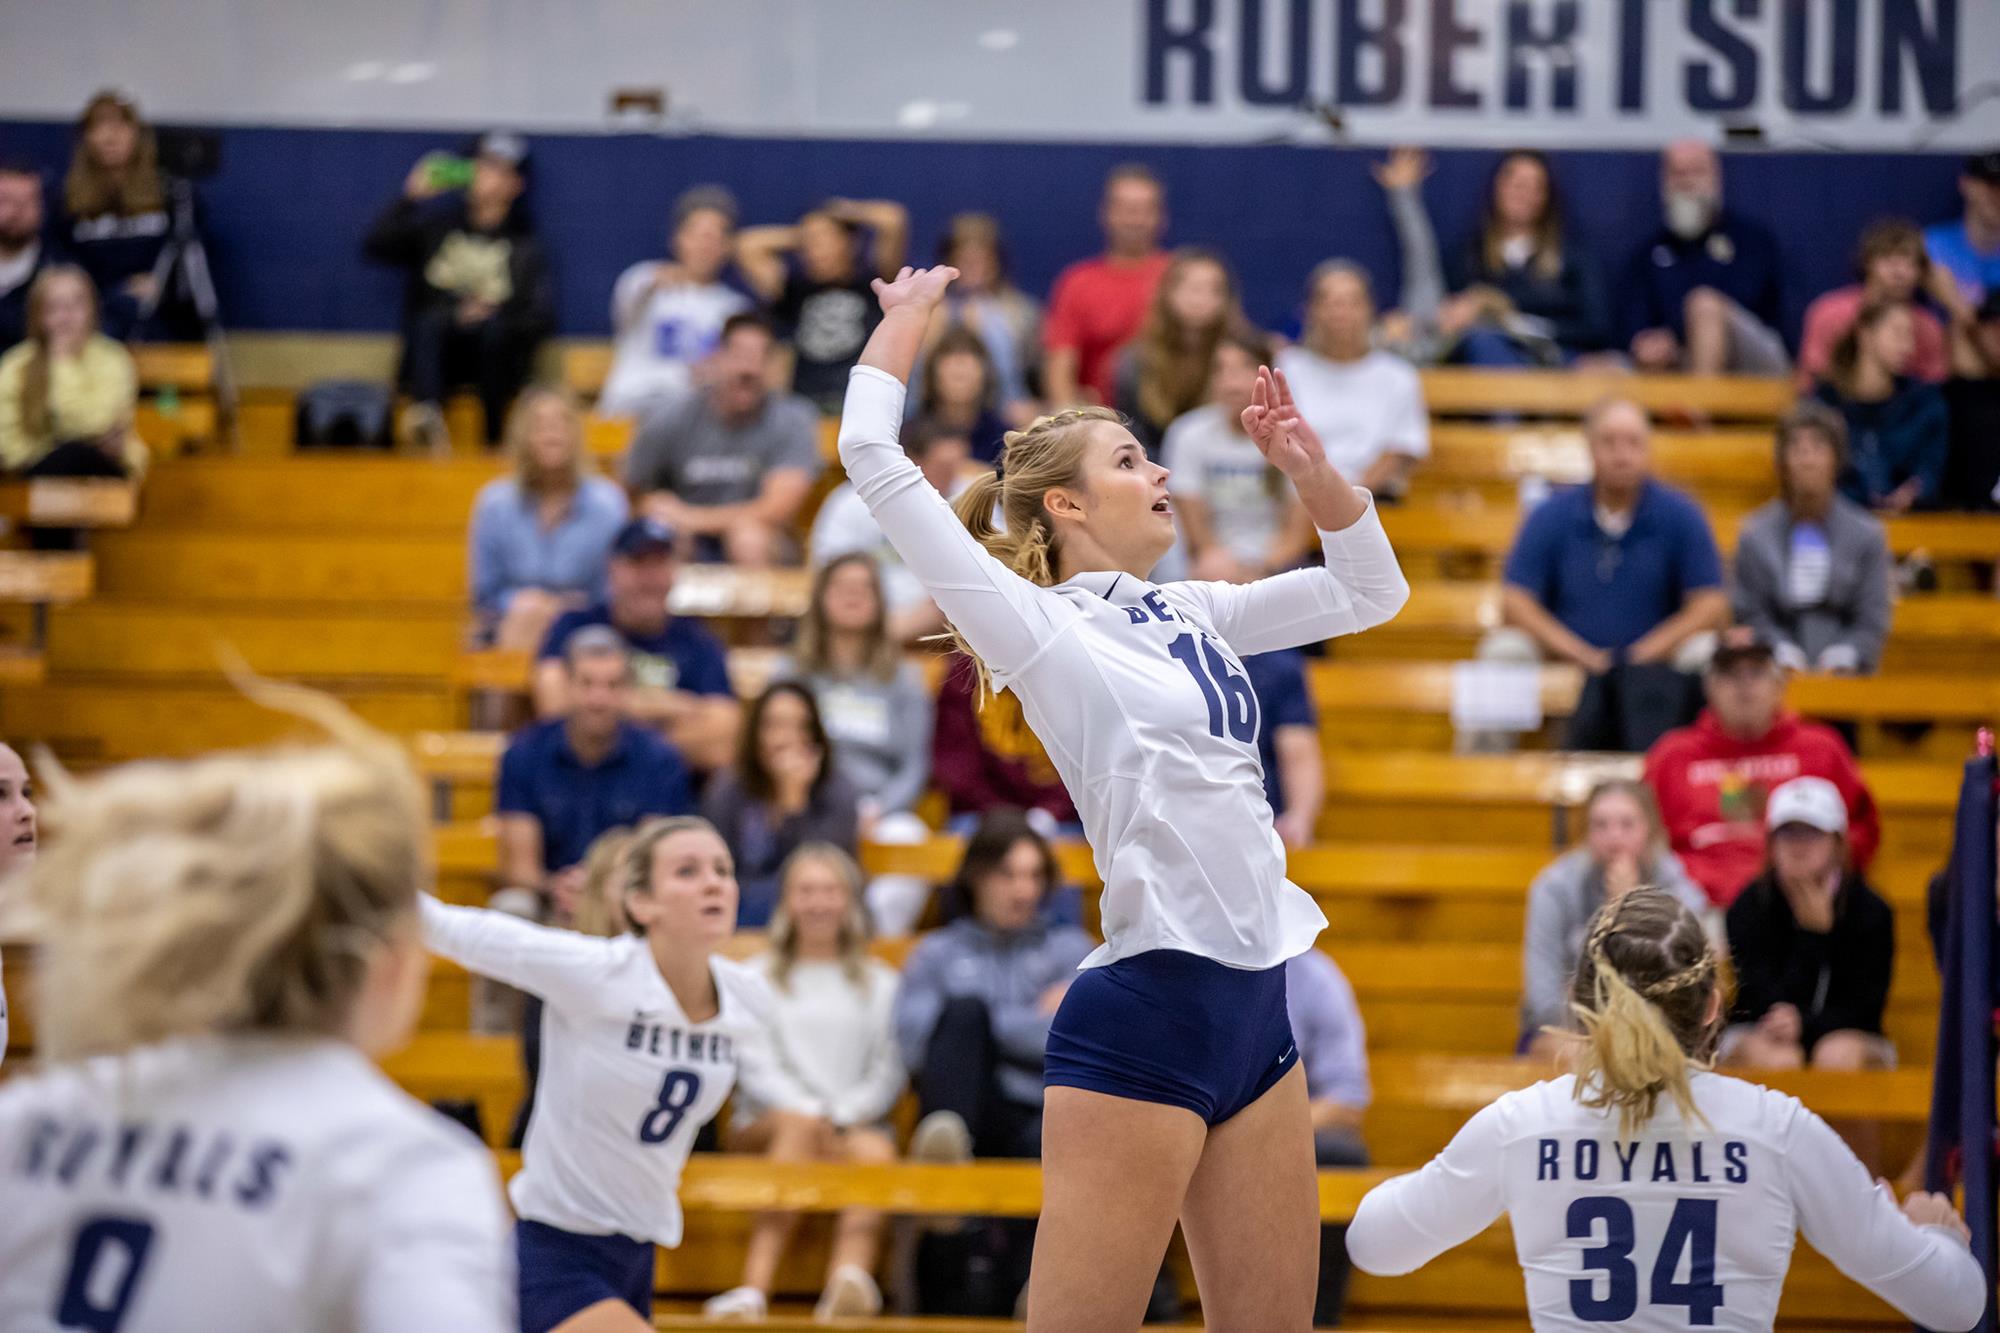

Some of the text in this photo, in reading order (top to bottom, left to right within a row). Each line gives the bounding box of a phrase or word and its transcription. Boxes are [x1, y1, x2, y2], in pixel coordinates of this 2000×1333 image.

[1167, 632, 1259, 744] 16
[640, 1070, 701, 1144] 8
[1537, 1138, 1748, 1184] ROYALS
[1565, 1195, 1724, 1326] 34
